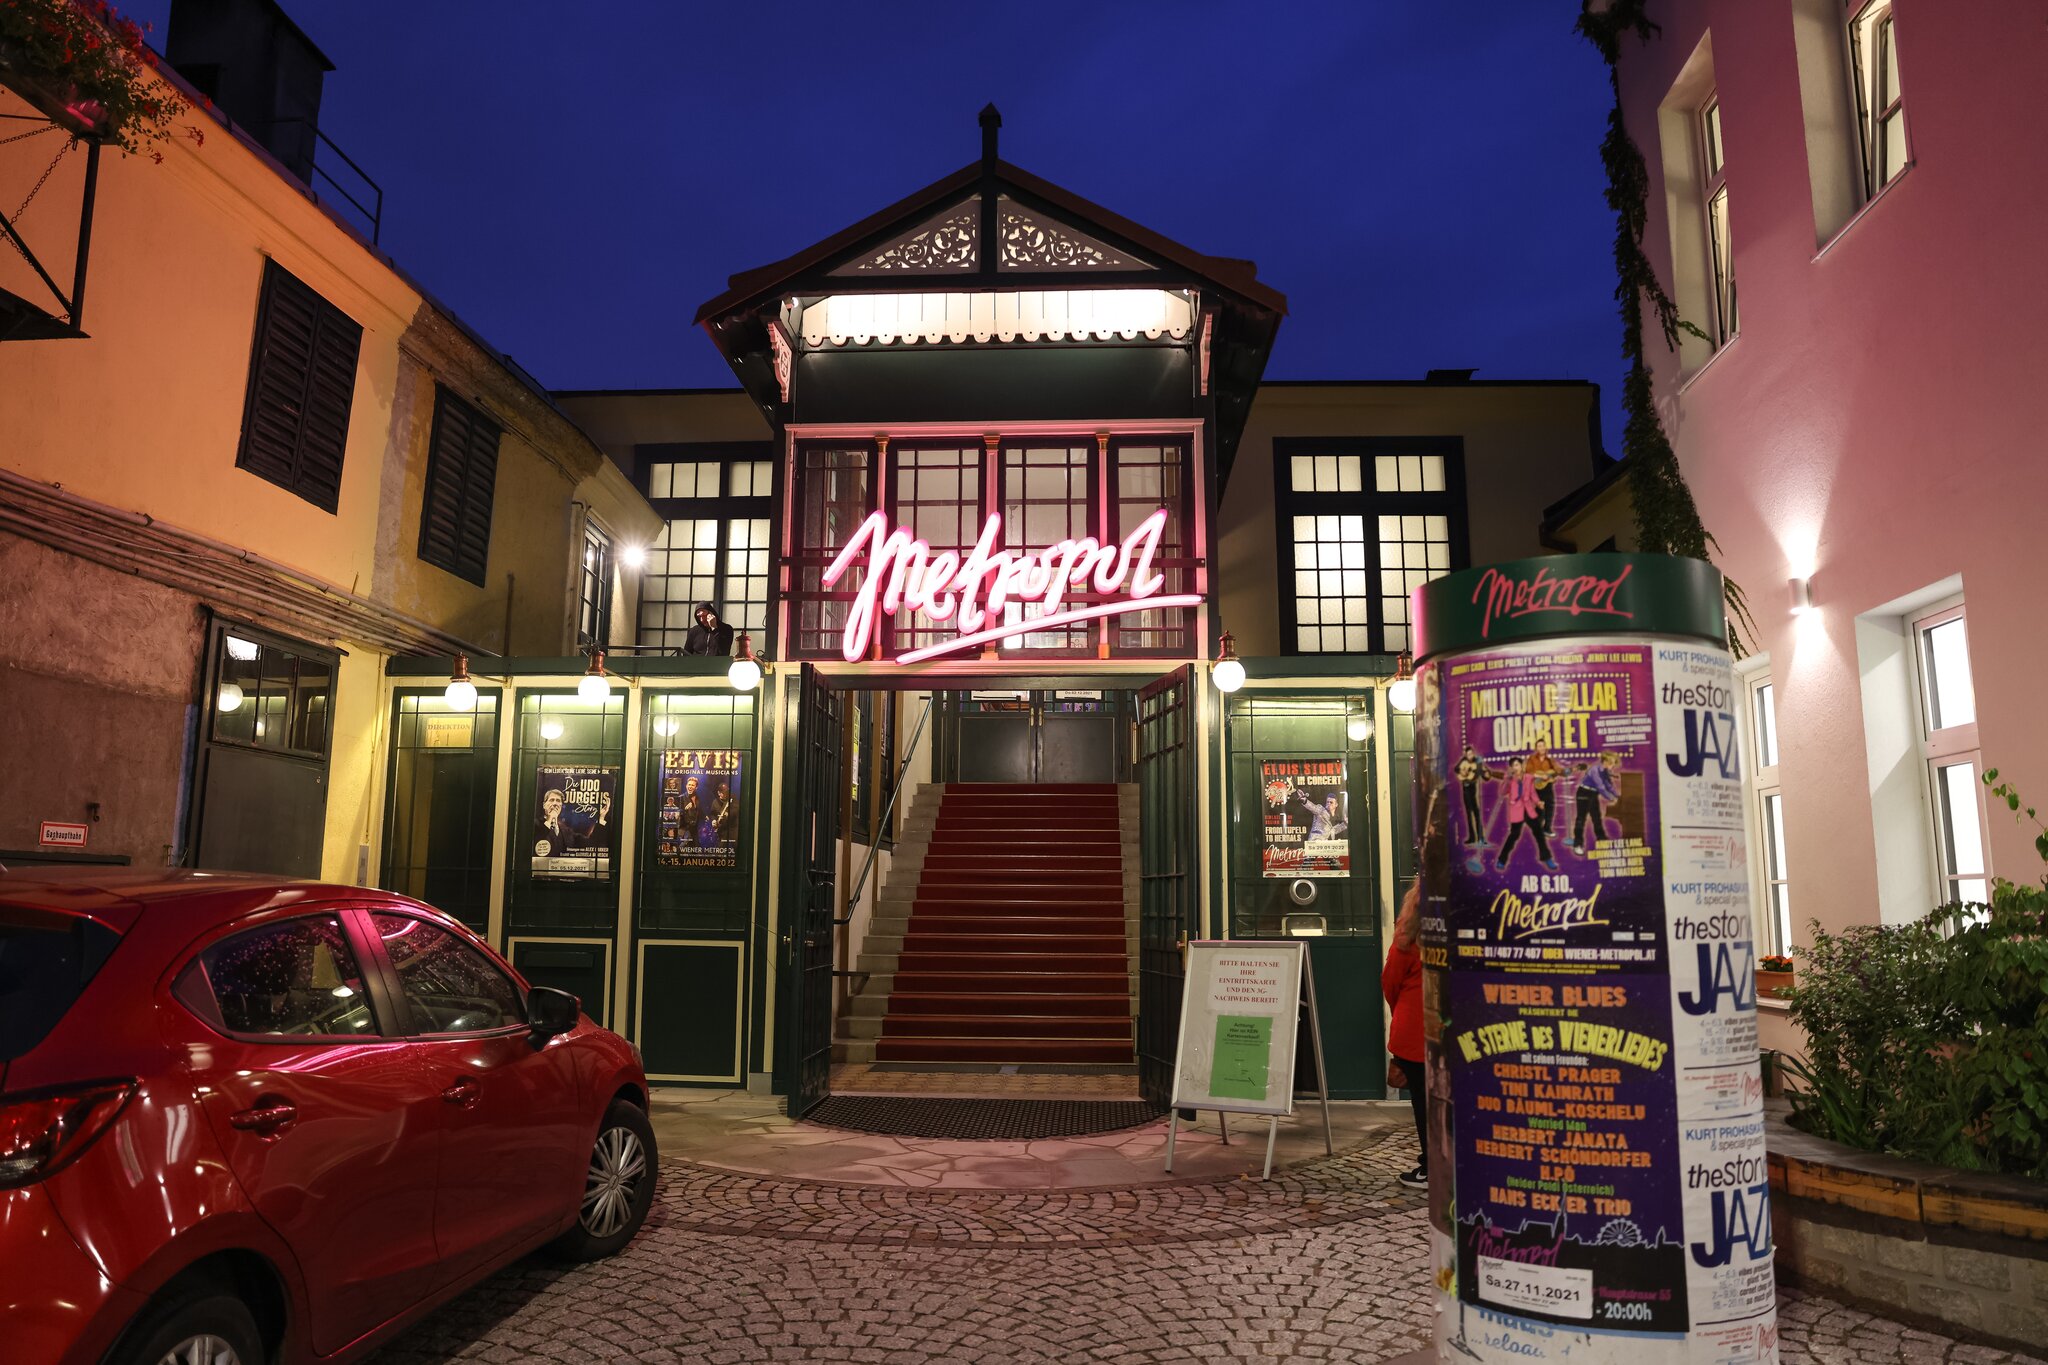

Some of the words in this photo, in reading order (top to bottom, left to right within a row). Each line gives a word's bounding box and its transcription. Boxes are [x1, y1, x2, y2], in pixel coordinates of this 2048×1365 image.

[822, 508, 1201, 664] Metropol
[1472, 564, 1633, 638] Metropol
[1587, 653, 1608, 663] JERRY
[1609, 653, 1619, 662] LEE
[1621, 653, 1642, 663] LEWIS
[1659, 650, 1688, 661] KURT
[1471, 685, 1541, 718] MILLION
[1494, 713, 1590, 753] QUARTET
[666, 751, 739, 769] ELVIS
[1264, 763, 1298, 775] ELVIS
[1303, 763, 1342, 775] STORY
[564, 777, 579, 792] Die
[580, 779, 600, 791] UDO
[1297, 776, 1305, 785] IN
[1306, 775, 1342, 785] CONCERT
[564, 789, 610, 804] JÜRGENS
[574, 802, 598, 818] Story
[1265, 826, 1283, 834] FROM
[1283, 826, 1307, 834] TUPELO
[1265, 834, 1273, 842] TO
[682, 858, 715, 866] JANUAR
[1520, 875, 1539, 893] AB
[1540, 875, 1574, 894] 6.10.
[1671, 883, 1702, 894] KURT
[1490, 883, 1609, 940] Metropol
[1483, 984, 1554, 1006] WIENER
[1562, 986, 1627, 1008] BLUES
[1477, 1020, 1530, 1056] STERNE
[1531, 1026, 1554, 1050] DES
[1558, 1020, 1668, 1072] WIENERLIEDES
[1493, 1063, 1552, 1081] CHRISTL
[1558, 1068, 1621, 1084] PRAGER
[1501, 1081, 1528, 1097] TINI
[1534, 1083, 1615, 1102] KAINRATH
[1477, 1095, 1501, 1112] DUO
[1527, 1117, 1564, 1130] Worried
[1492, 1124, 1556, 1146] HERBERT
[1562, 1131, 1629, 1150] JANATA
[1686, 1127, 1717, 1141] KURT
[1475, 1138, 1534, 1161] HERBERT
[1540, 1147, 1652, 1167] SCHÖNDORFER
[1719, 1137, 1746, 1152] special
[1489, 1186, 1527, 1208] HANS
[1593, 1198, 1631, 1216] TRIO
[1485, 1274, 1581, 1301] Sa.27.11.2021
[1604, 1302, 1652, 1320] 20:00h
